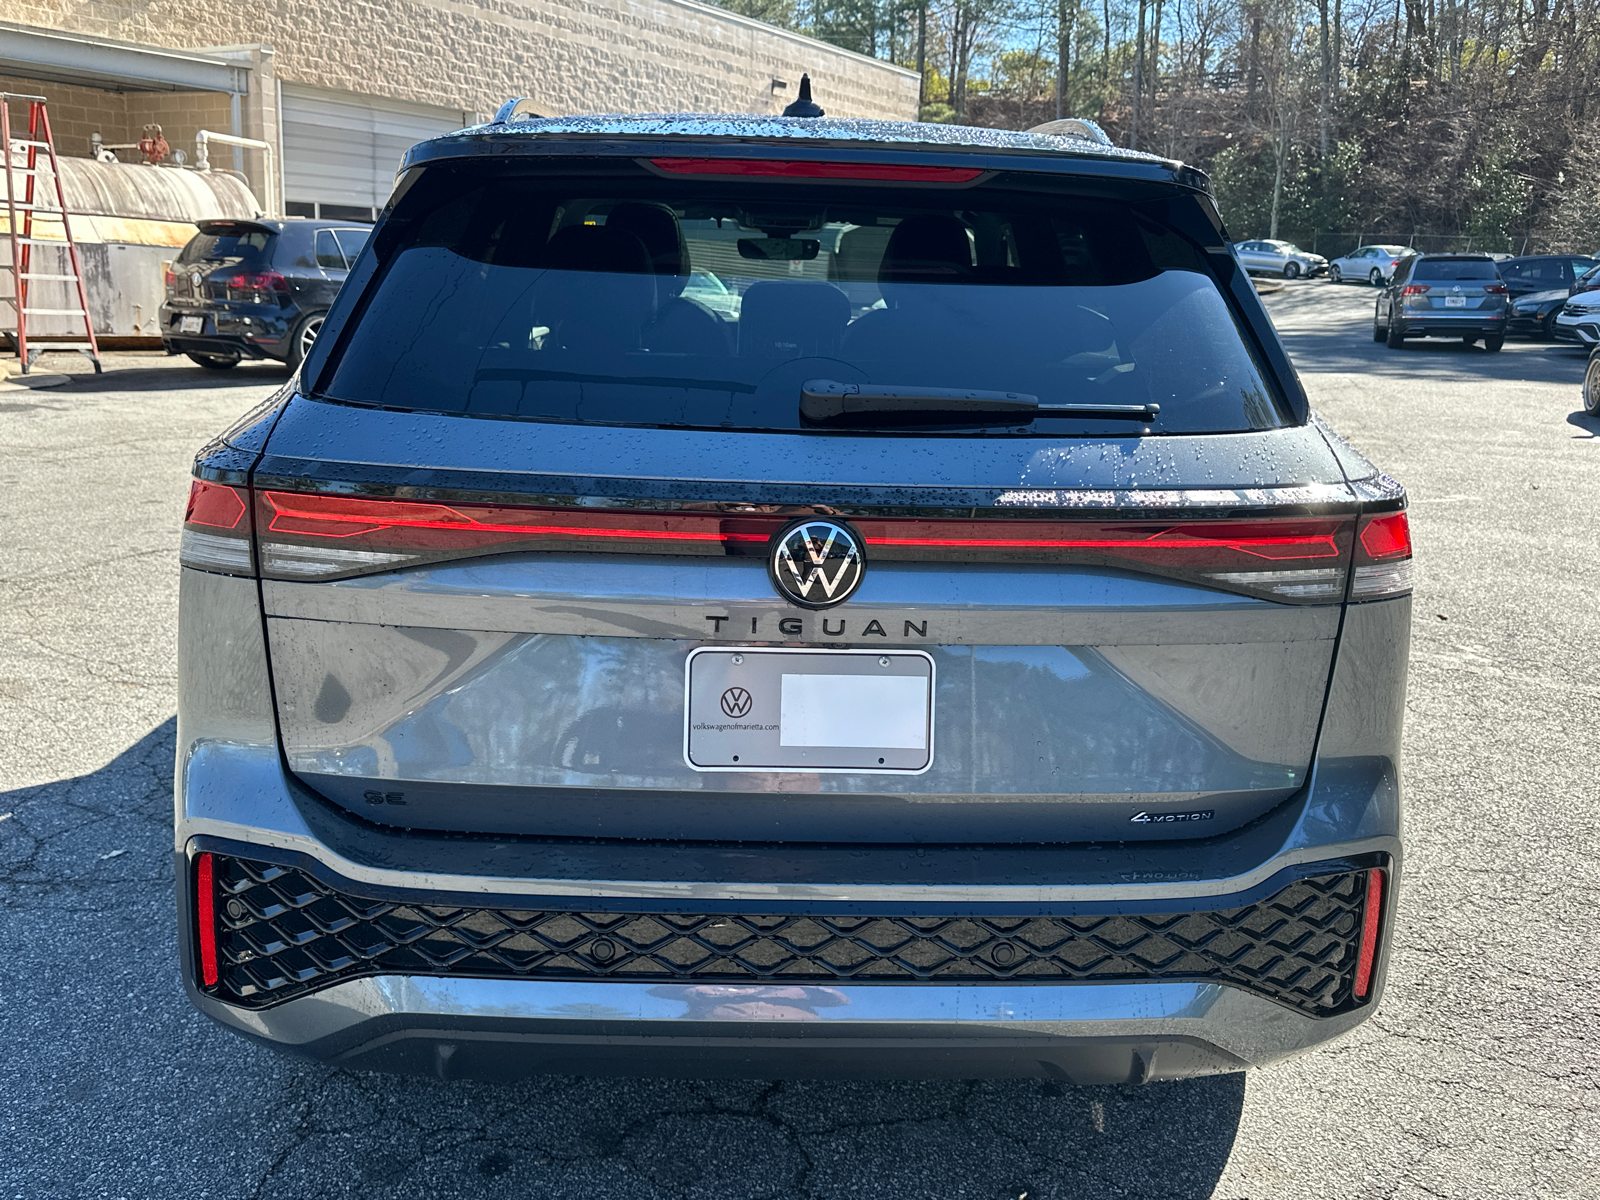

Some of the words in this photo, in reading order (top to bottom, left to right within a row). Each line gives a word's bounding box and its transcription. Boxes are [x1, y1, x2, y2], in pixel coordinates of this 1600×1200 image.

[775, 521, 861, 604] VW
[706, 615, 928, 637] TIGUAN
[720, 687, 752, 718] VW
[692, 722, 780, 732] volkswagenofmarietta.com
[363, 790, 407, 805] SE
[1130, 811, 1212, 824] 4MOTION
